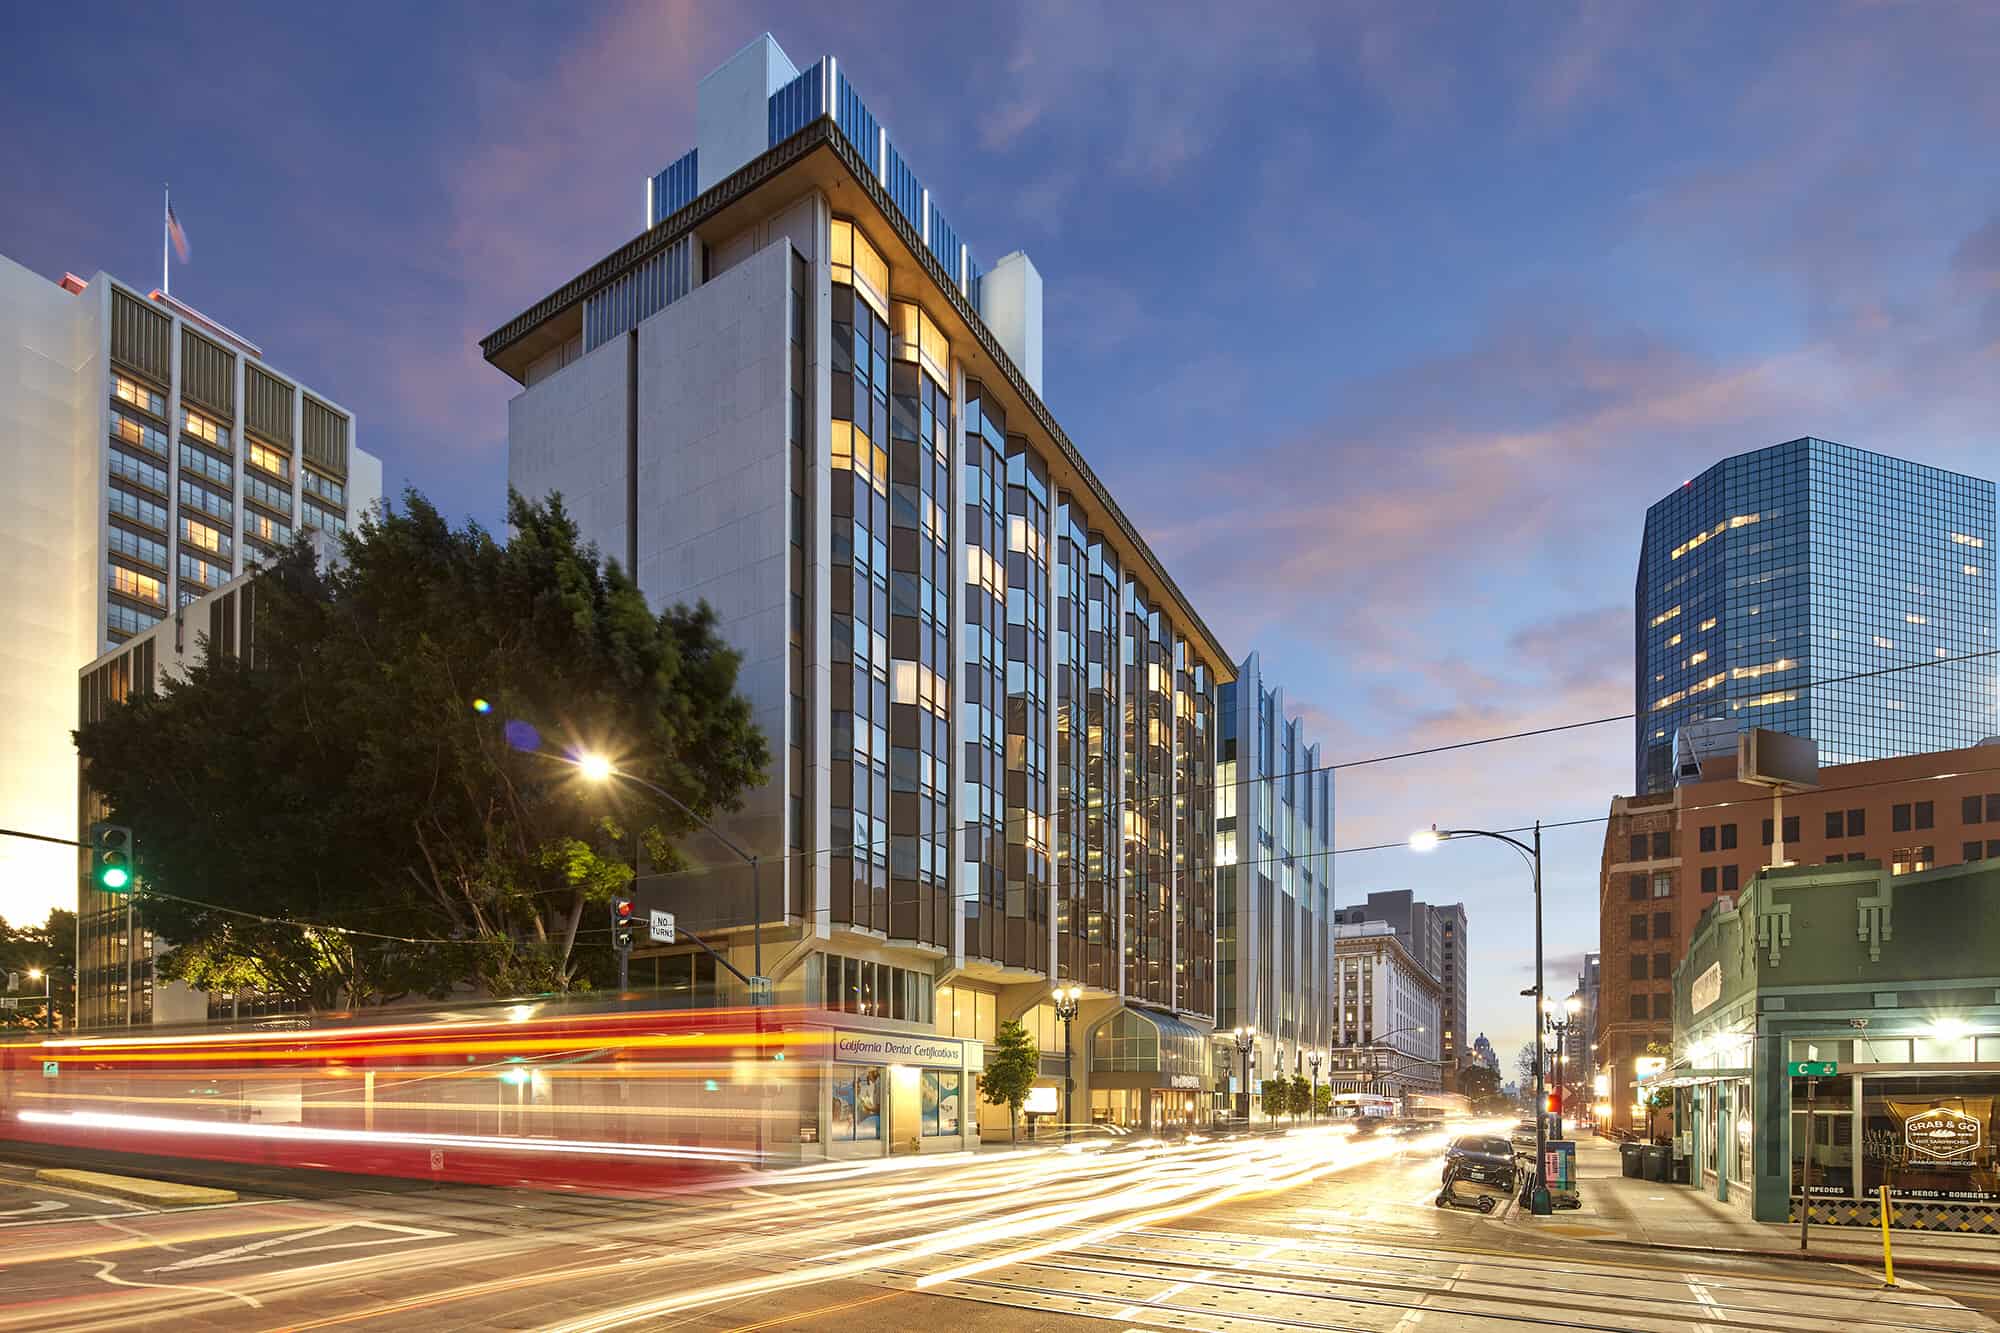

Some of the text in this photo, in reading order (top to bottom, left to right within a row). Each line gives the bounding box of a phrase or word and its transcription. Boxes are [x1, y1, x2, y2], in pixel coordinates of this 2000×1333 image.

[657, 917, 668, 926] NO
[652, 927, 673, 937] TURNS
[840, 1038, 958, 1060] California Dental Certifications
[1798, 1063, 1808, 1074] C
[1909, 1120, 1977, 1132] GRAB & GO
[1800, 1186, 1845, 1194] TRPEDOES
